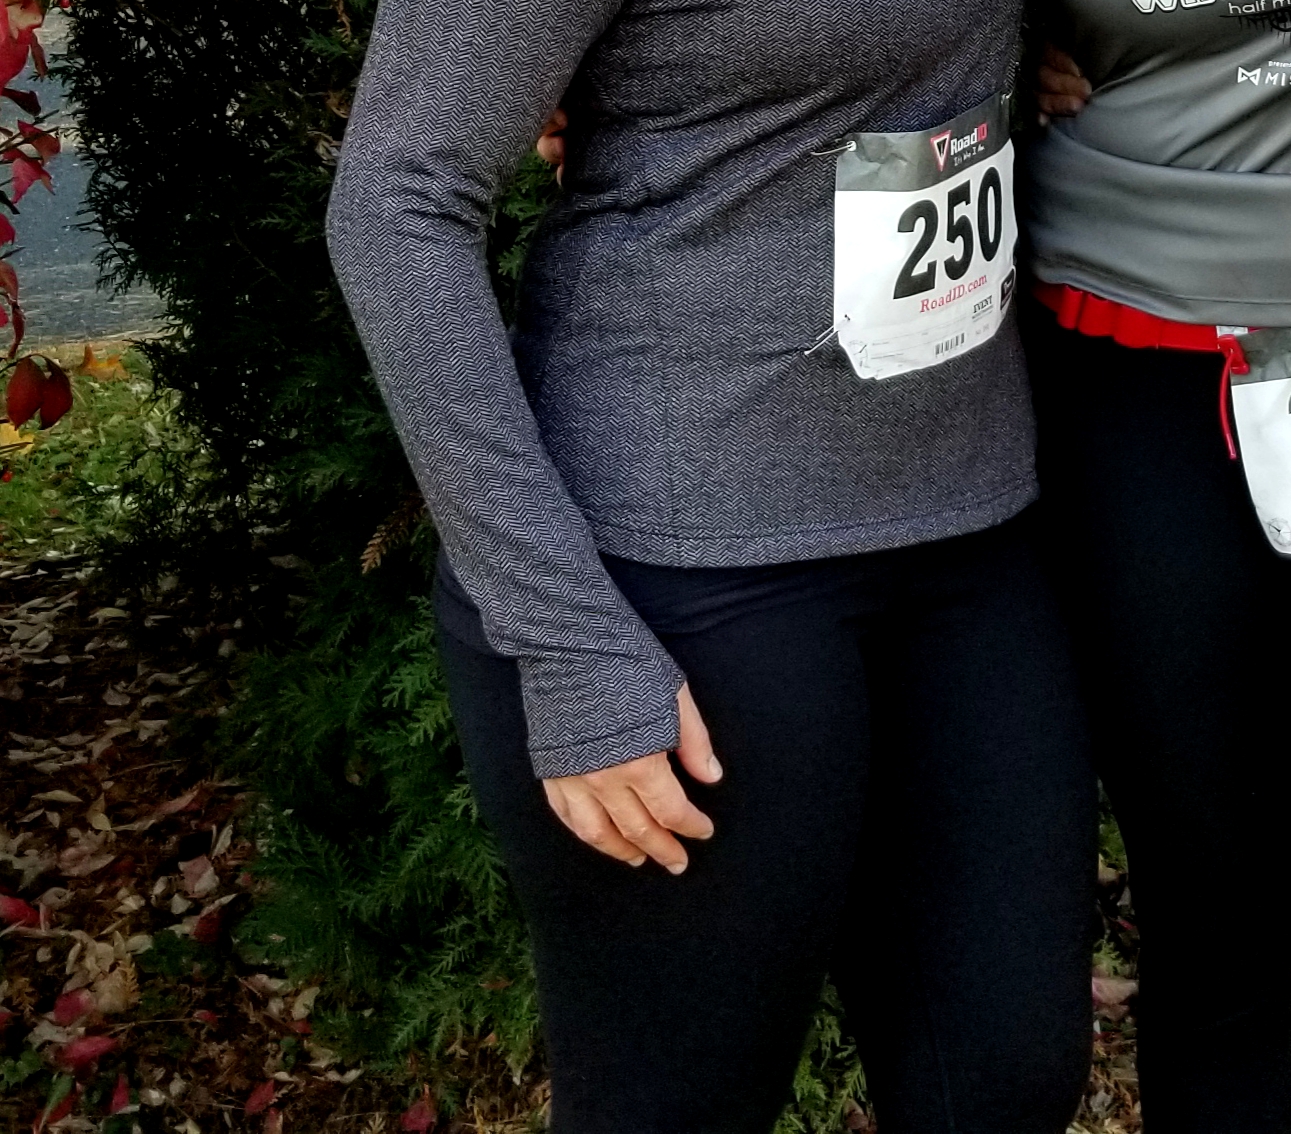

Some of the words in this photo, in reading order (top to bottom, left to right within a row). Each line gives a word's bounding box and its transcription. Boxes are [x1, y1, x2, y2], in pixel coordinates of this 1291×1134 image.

[1227, 0, 1266, 16] half
[950, 123, 988, 156] RoadID
[893, 166, 1003, 300] 250
[919, 274, 988, 314] RoadID.com
